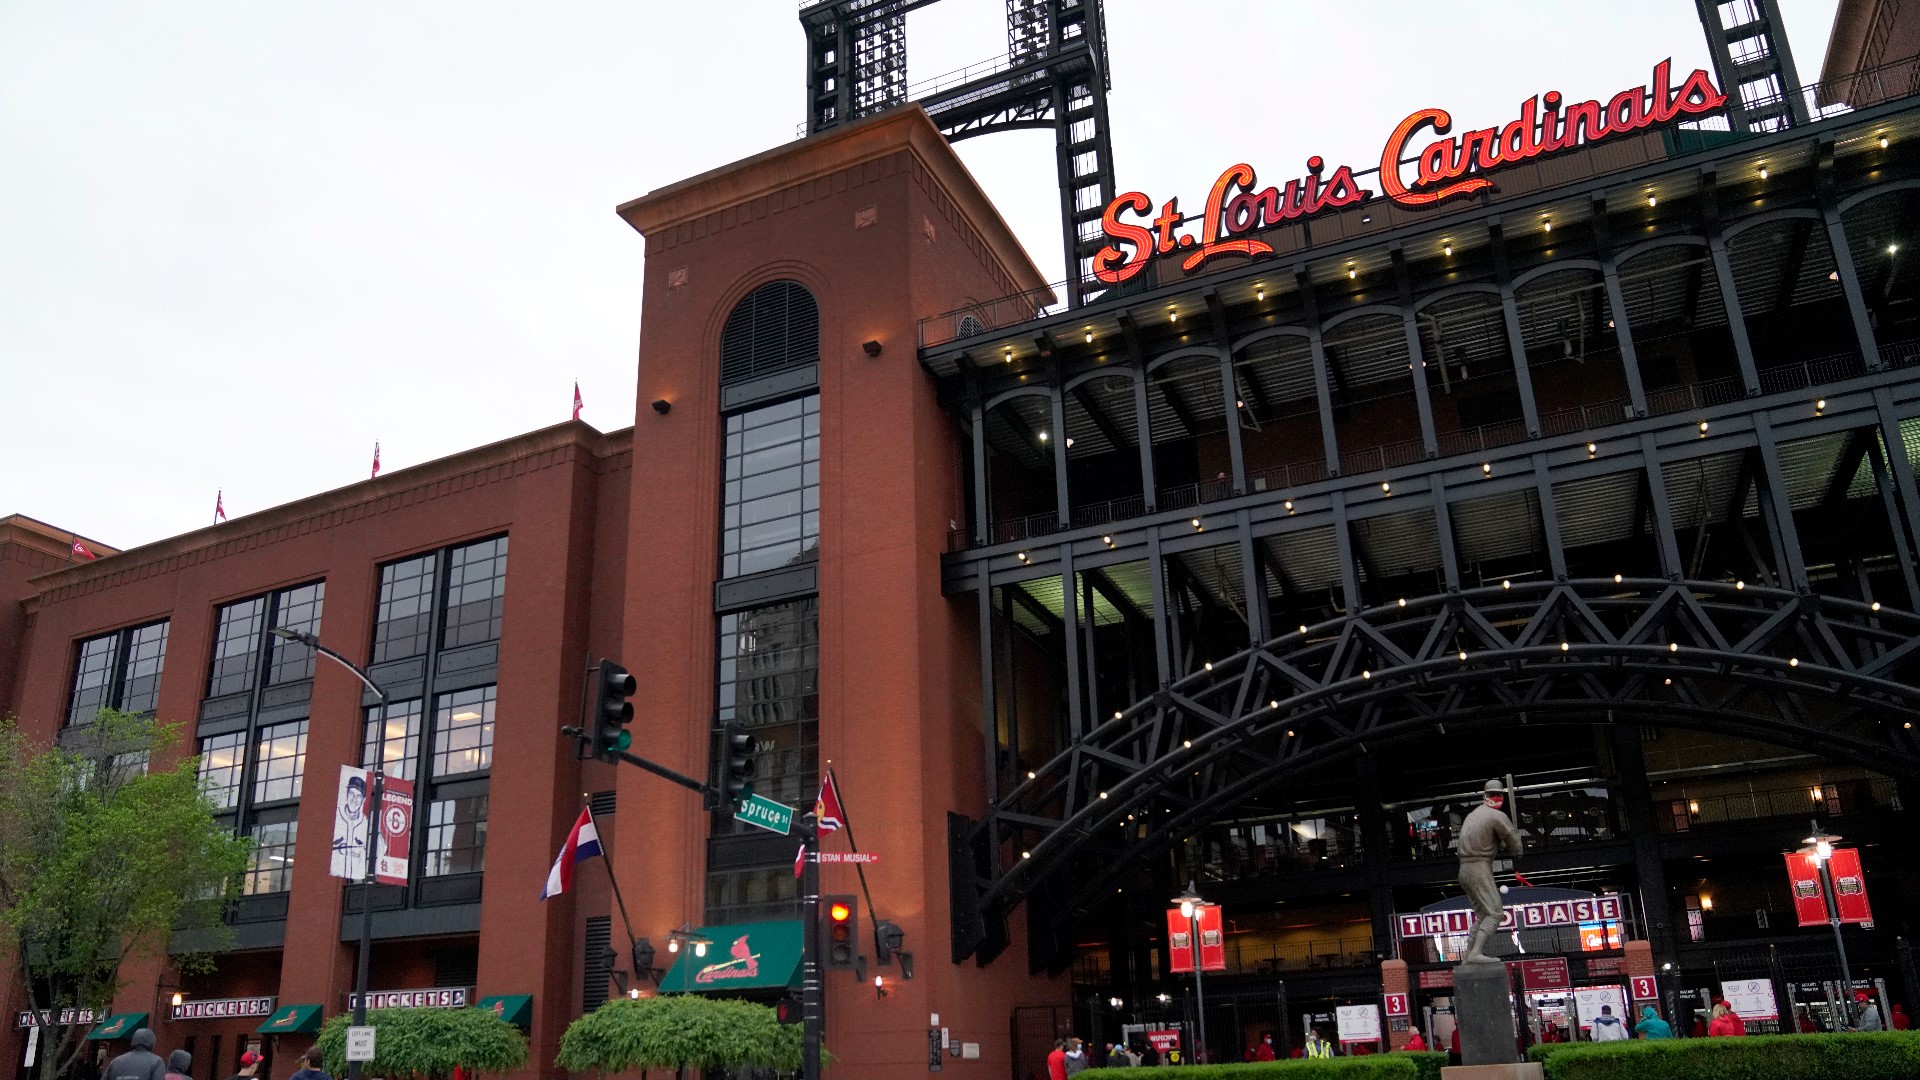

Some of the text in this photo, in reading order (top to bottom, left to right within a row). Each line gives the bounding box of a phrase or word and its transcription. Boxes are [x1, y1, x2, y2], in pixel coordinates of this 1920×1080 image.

[1092, 56, 1728, 284] St. Louis Cardinals
[382, 792, 413, 807] LEGEND
[391, 810, 402, 831] 6
[740, 799, 780, 824] Spruce
[821, 853, 841, 862] STAN
[843, 853, 871, 863] MUSIAL
[1405, 901, 1614, 934] THID BASE
[695, 964, 758, 983] Cardinals
[1639, 979, 1650, 996] 3
[184, 1001, 257, 1017] TICKETS
[1391, 996, 1401, 1012] 3
